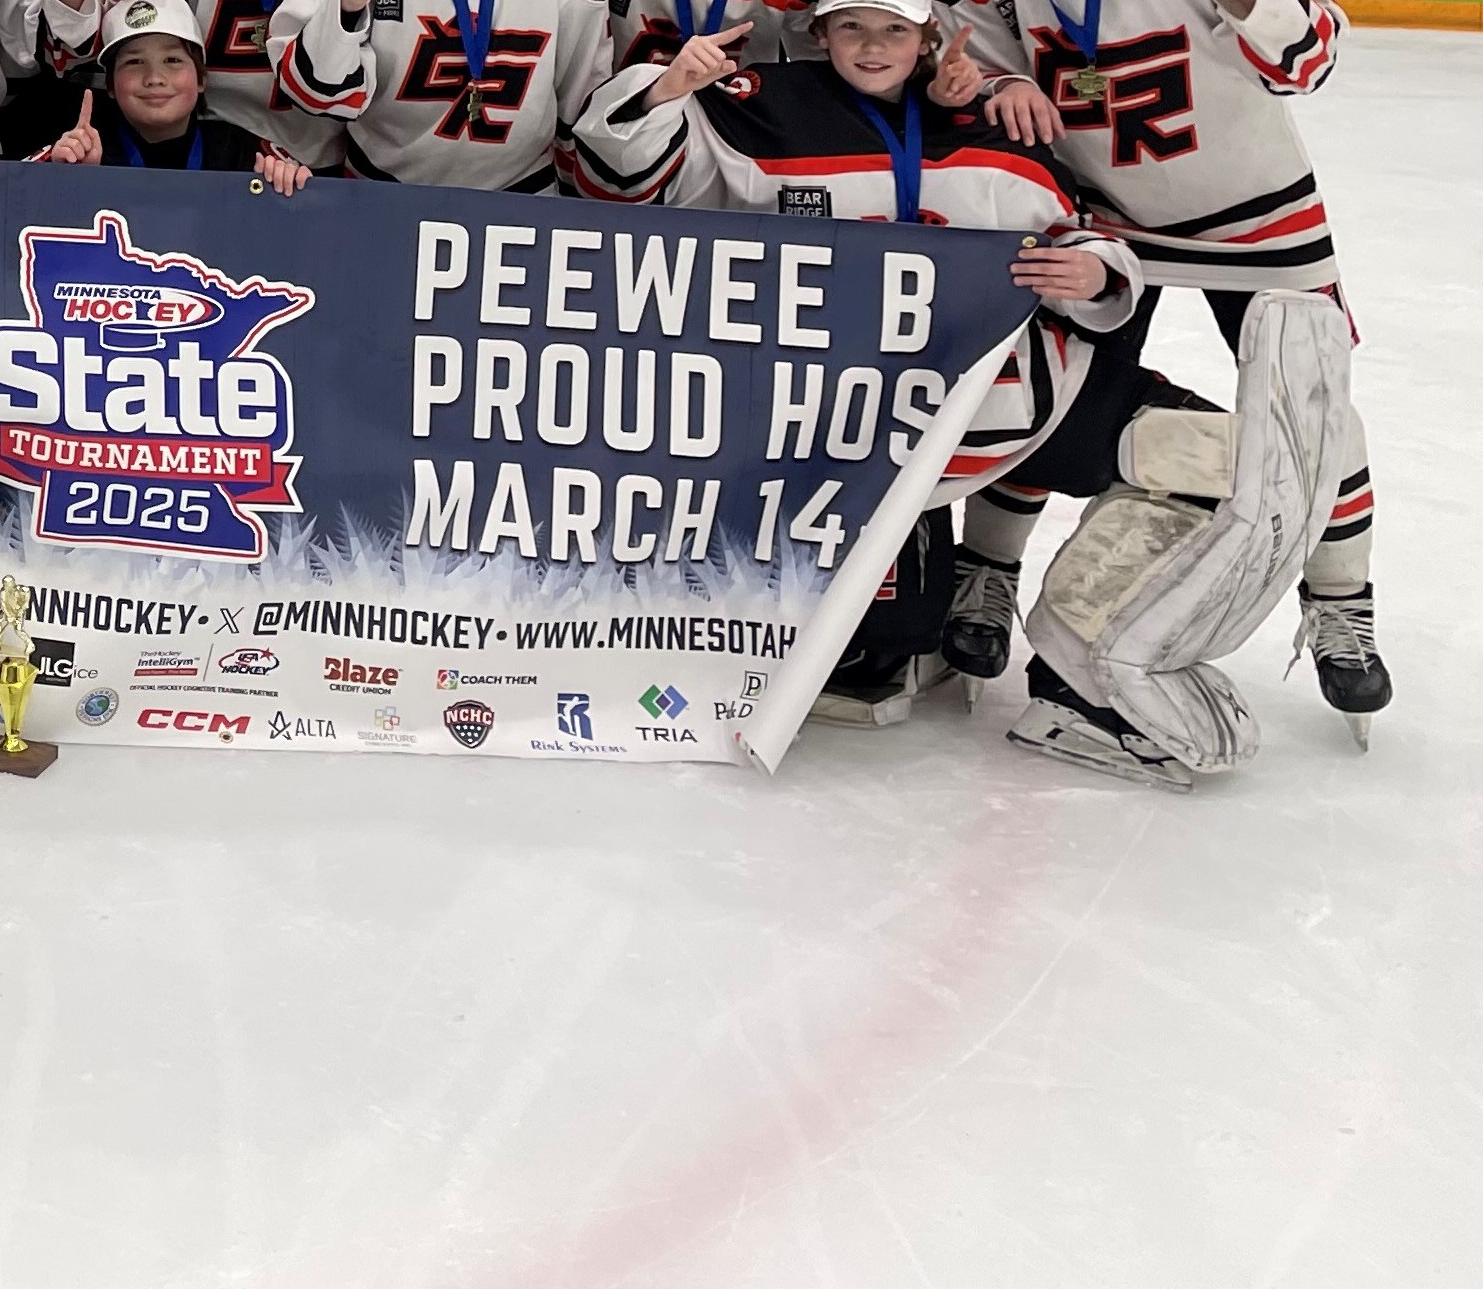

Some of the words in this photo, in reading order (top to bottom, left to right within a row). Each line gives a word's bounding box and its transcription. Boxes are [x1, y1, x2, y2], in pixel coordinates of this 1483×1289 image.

[785, 191, 822, 205] BEAR
[55, 285, 162, 300] MINNESOTA
[414, 221, 833, 349] PEEWEE
[879, 252, 937, 352] B
[66, 298, 198, 323] HOCKEY
[411, 334, 723, 459] PROUD
[765, 361, 949, 467] HOS
[9, 429, 261, 476] TOURNAMENT
[66, 481, 211, 533] 2025
[405, 459, 720, 564] MARCH
[138, 658, 194, 668] IntelliGym
[221, 666, 272, 675] HOCKEY
[323, 657, 399, 686] Blaze
[461, 675, 502, 685] COACH
[505, 675, 537, 685] THEM
[249, 689, 278, 697] PARTNER
[330, 684, 360, 694] CREDIT
[363, 687, 391, 695] UNION
[137, 709, 251, 734] CCM
[446, 709, 493, 725] NCHC
[295, 718, 337, 740] ALTA
[357, 731, 417, 743] SIGNATURE
[636, 727, 698, 743] TRIA
